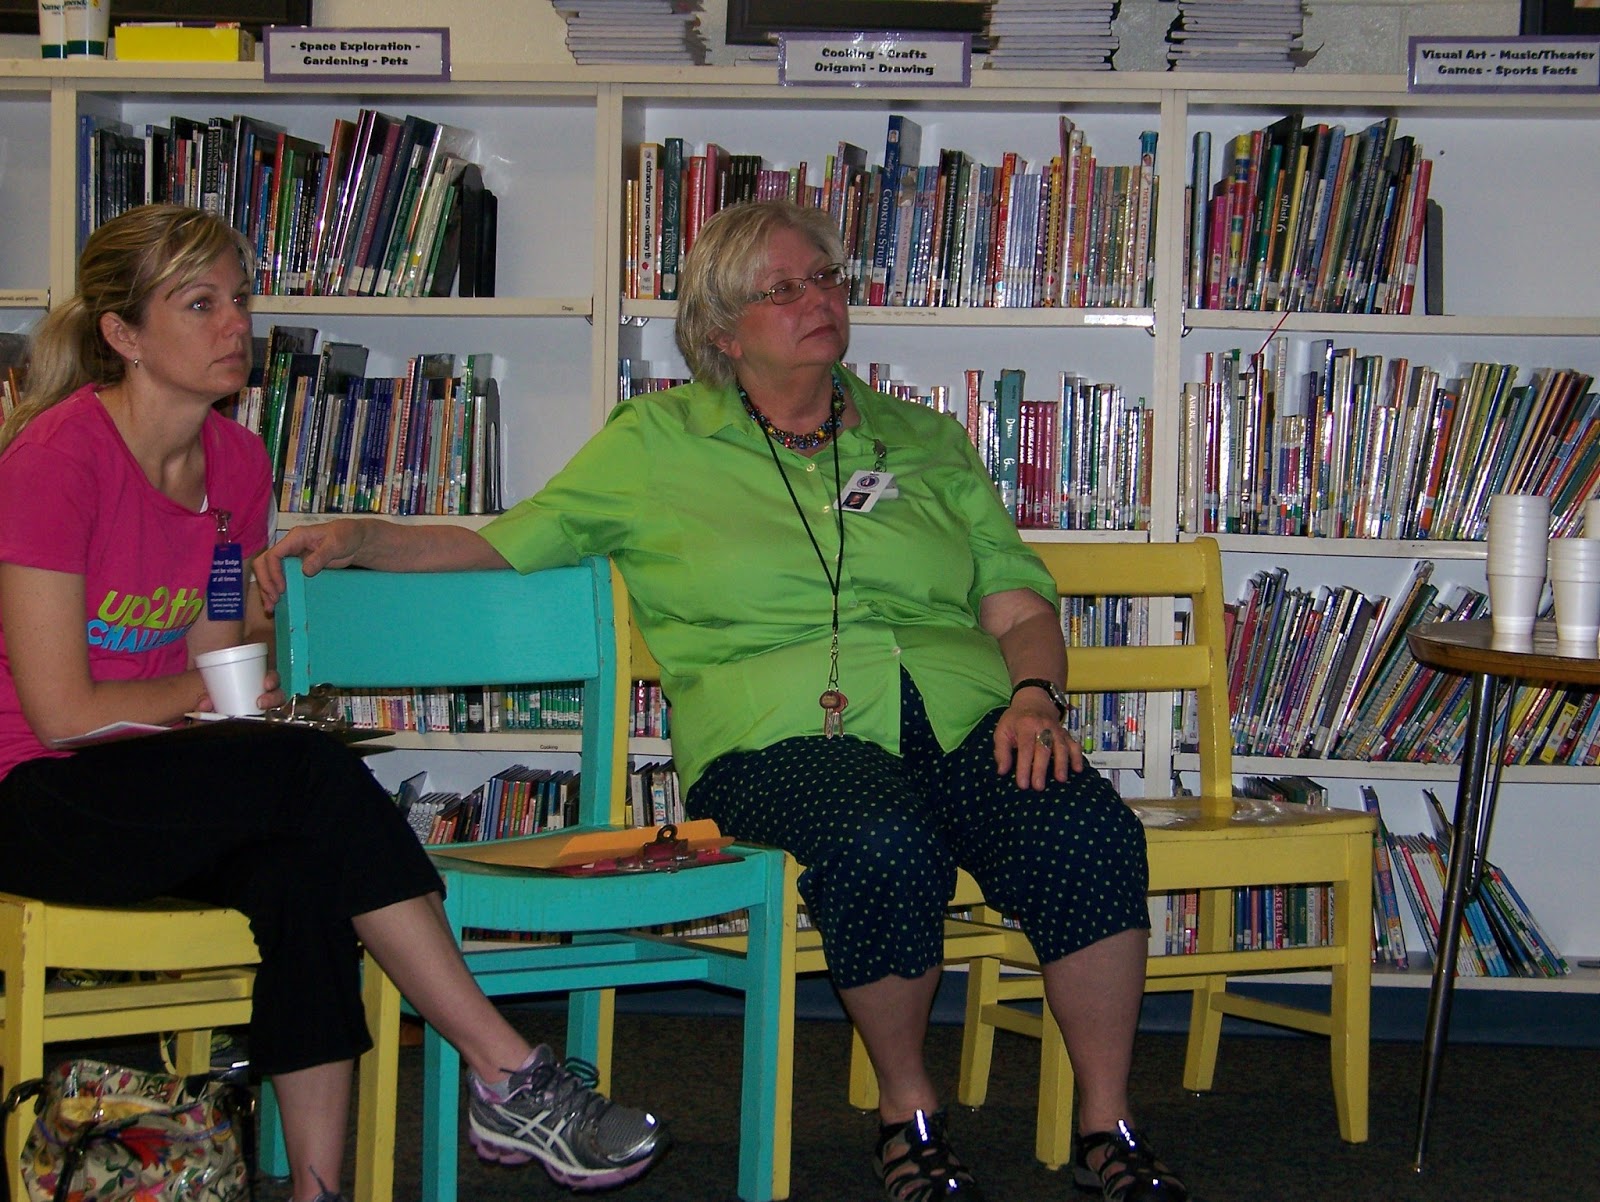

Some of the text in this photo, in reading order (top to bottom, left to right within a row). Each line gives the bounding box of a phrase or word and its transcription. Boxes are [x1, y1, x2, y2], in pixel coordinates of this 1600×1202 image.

[299, 42, 337, 52] Space
[340, 41, 412, 53] Exploration
[822, 48, 875, 59] Cooking
[887, 49, 928, 59] Crafts
[303, 56, 369, 67] Gardening
[381, 56, 409, 65] Pets
[1422, 50, 1462, 60] Visual
[1465, 50, 1487, 60] Art
[1500, 50, 1595, 61] Music/Theater
[814, 62, 867, 73] Origami
[878, 63, 935, 75] Drawing
[1438, 65, 1483, 75] Games
[1495, 65, 1538, 77] Sports
[1542, 65, 1578, 75] Facts
[644, 160, 653, 202] extraordinary
[879, 187, 893, 235] COOKING
[1279, 194, 1291, 222] splash
[643, 224, 652, 250] ordinary
[663, 226, 675, 271] TENNESSEE
[225, 559, 239, 567] Badge
[1275, 891, 1283, 938] SKETBALL
